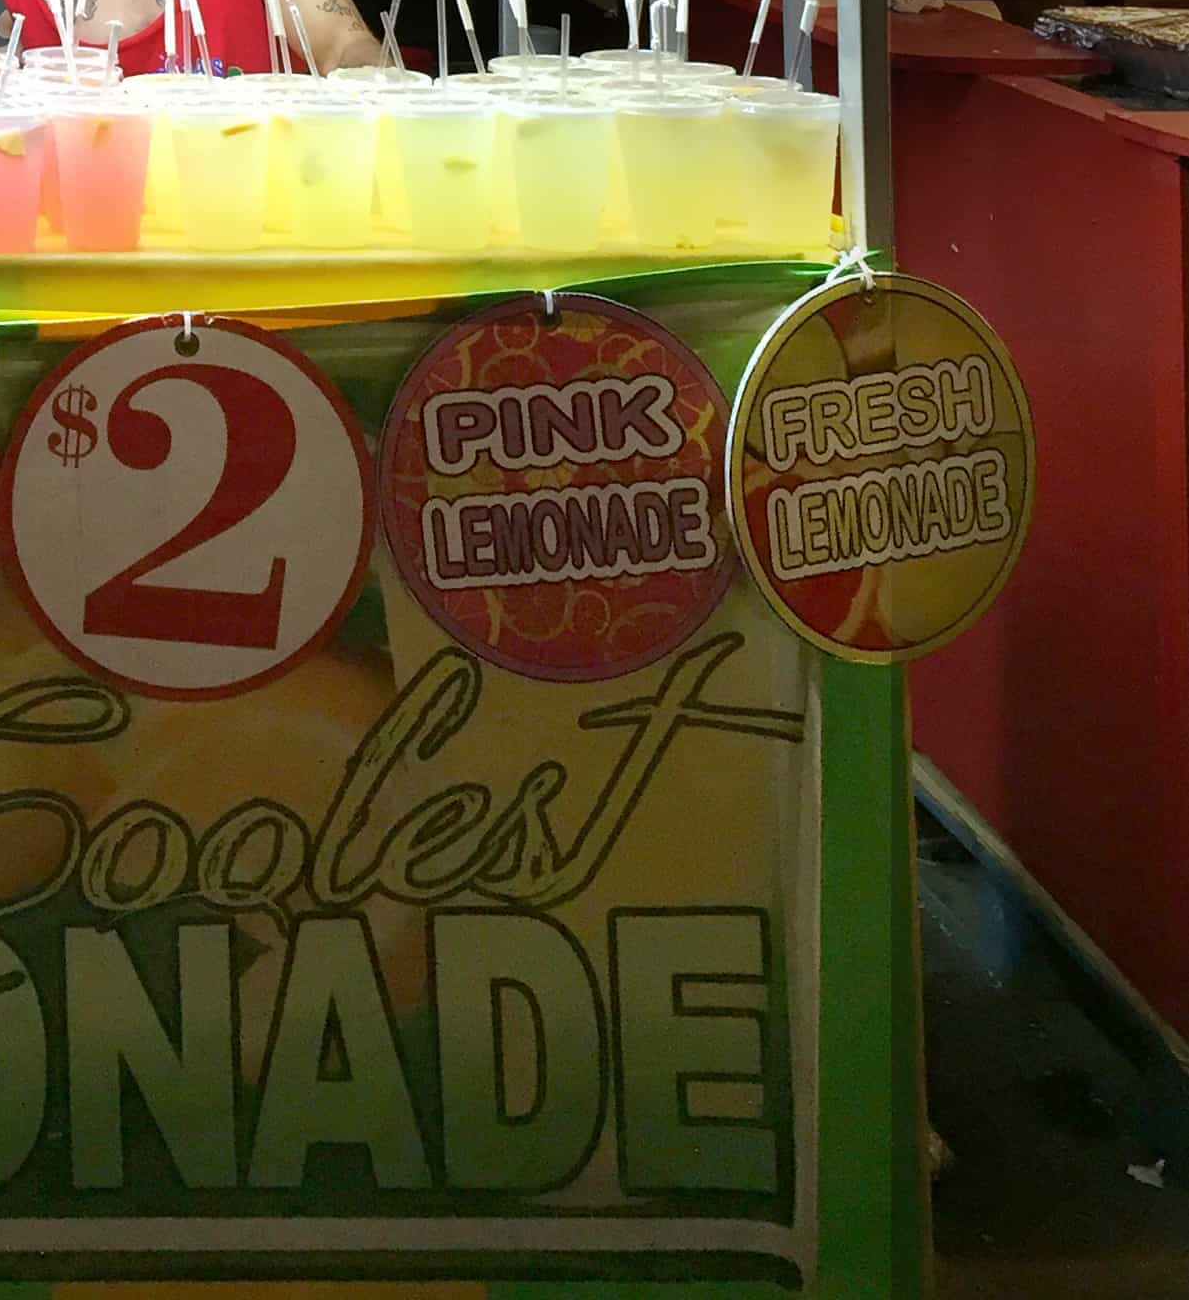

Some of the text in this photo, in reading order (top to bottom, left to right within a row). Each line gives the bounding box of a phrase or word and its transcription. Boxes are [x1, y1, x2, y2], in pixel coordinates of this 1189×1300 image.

[436, 384, 672, 467] PINK
[770, 362, 986, 465] FRESH
[46, 362, 297, 651] $2
[431, 487, 708, 580] LEMONADE
[773, 458, 1007, 571] LEMONADE
